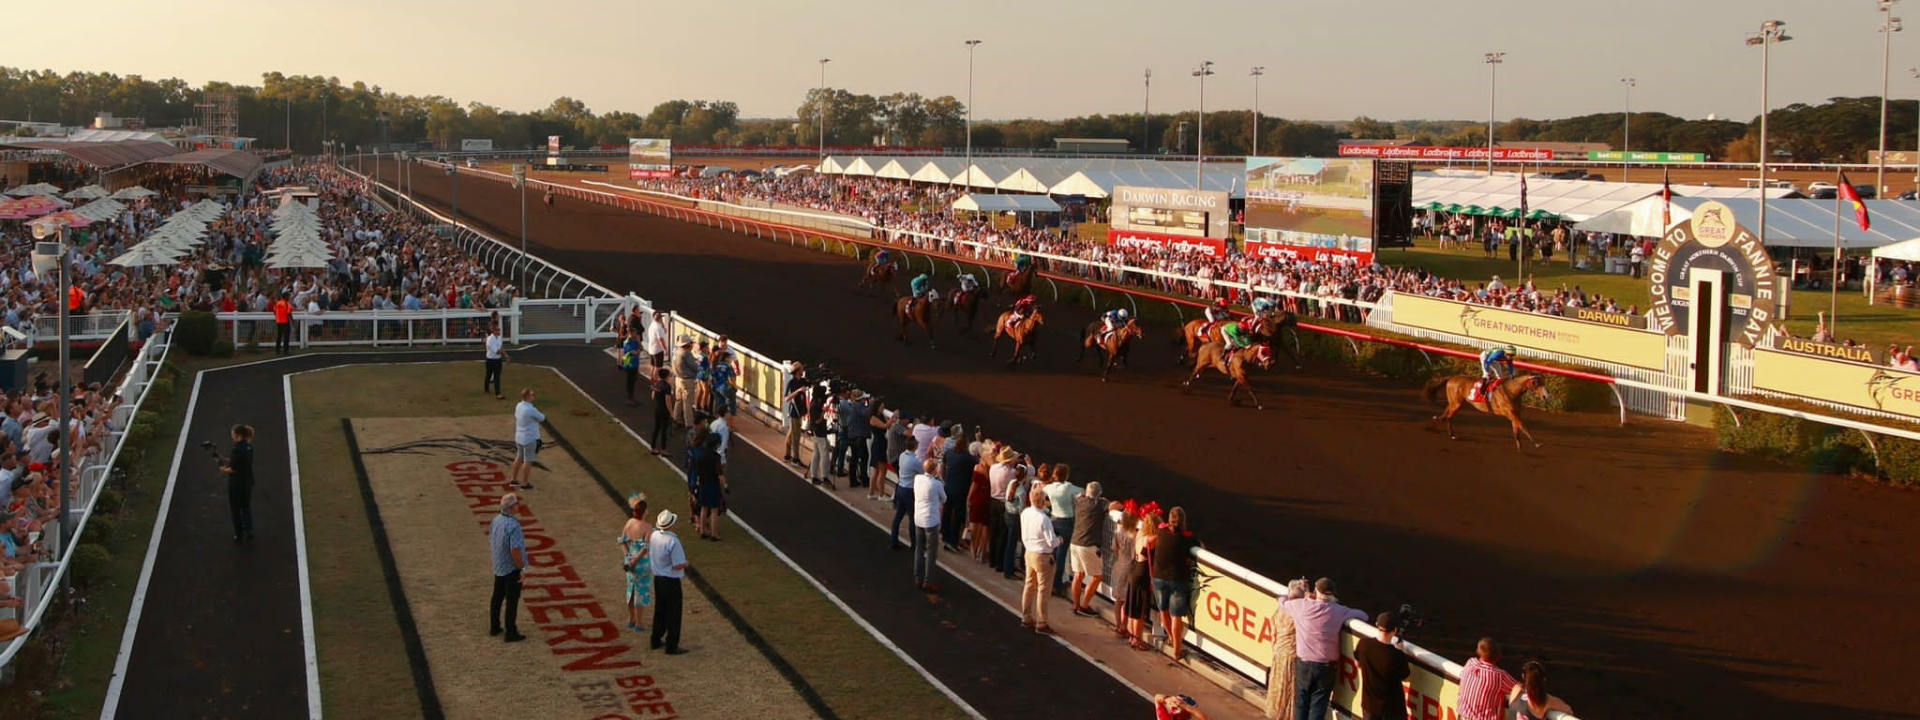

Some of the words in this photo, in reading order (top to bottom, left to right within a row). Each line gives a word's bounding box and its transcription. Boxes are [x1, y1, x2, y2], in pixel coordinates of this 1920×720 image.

[1383, 147, 1419, 156] Ladbrokes
[1423, 148, 1461, 156] Ladbrokes
[1465, 149, 1503, 157] Ladbroes
[1507, 149, 1547, 158] Ladbrokes
[1123, 190, 1167, 204] DARWIN
[1172, 193, 1216, 207] RACING
[1699, 226, 1726, 235] GREAT
[1315, 251, 1358, 264] Laros
[1688, 249, 1719, 262] NORTHERN
[1735, 231, 1772, 300] FANNIE
[1651, 247, 1675, 331] WELCOME
[1666, 228, 1687, 247] TO
[1578, 309, 1630, 326] DARWIN
[1743, 307, 1768, 344] BAY
[1474, 319, 1504, 331] GREAT
[1504, 323, 1556, 341] NORTHERN
[1783, 339, 1873, 362] AUSTRALIA
[1891, 387, 1920, 402] GRE
[1206, 591, 1273, 643] GREA
